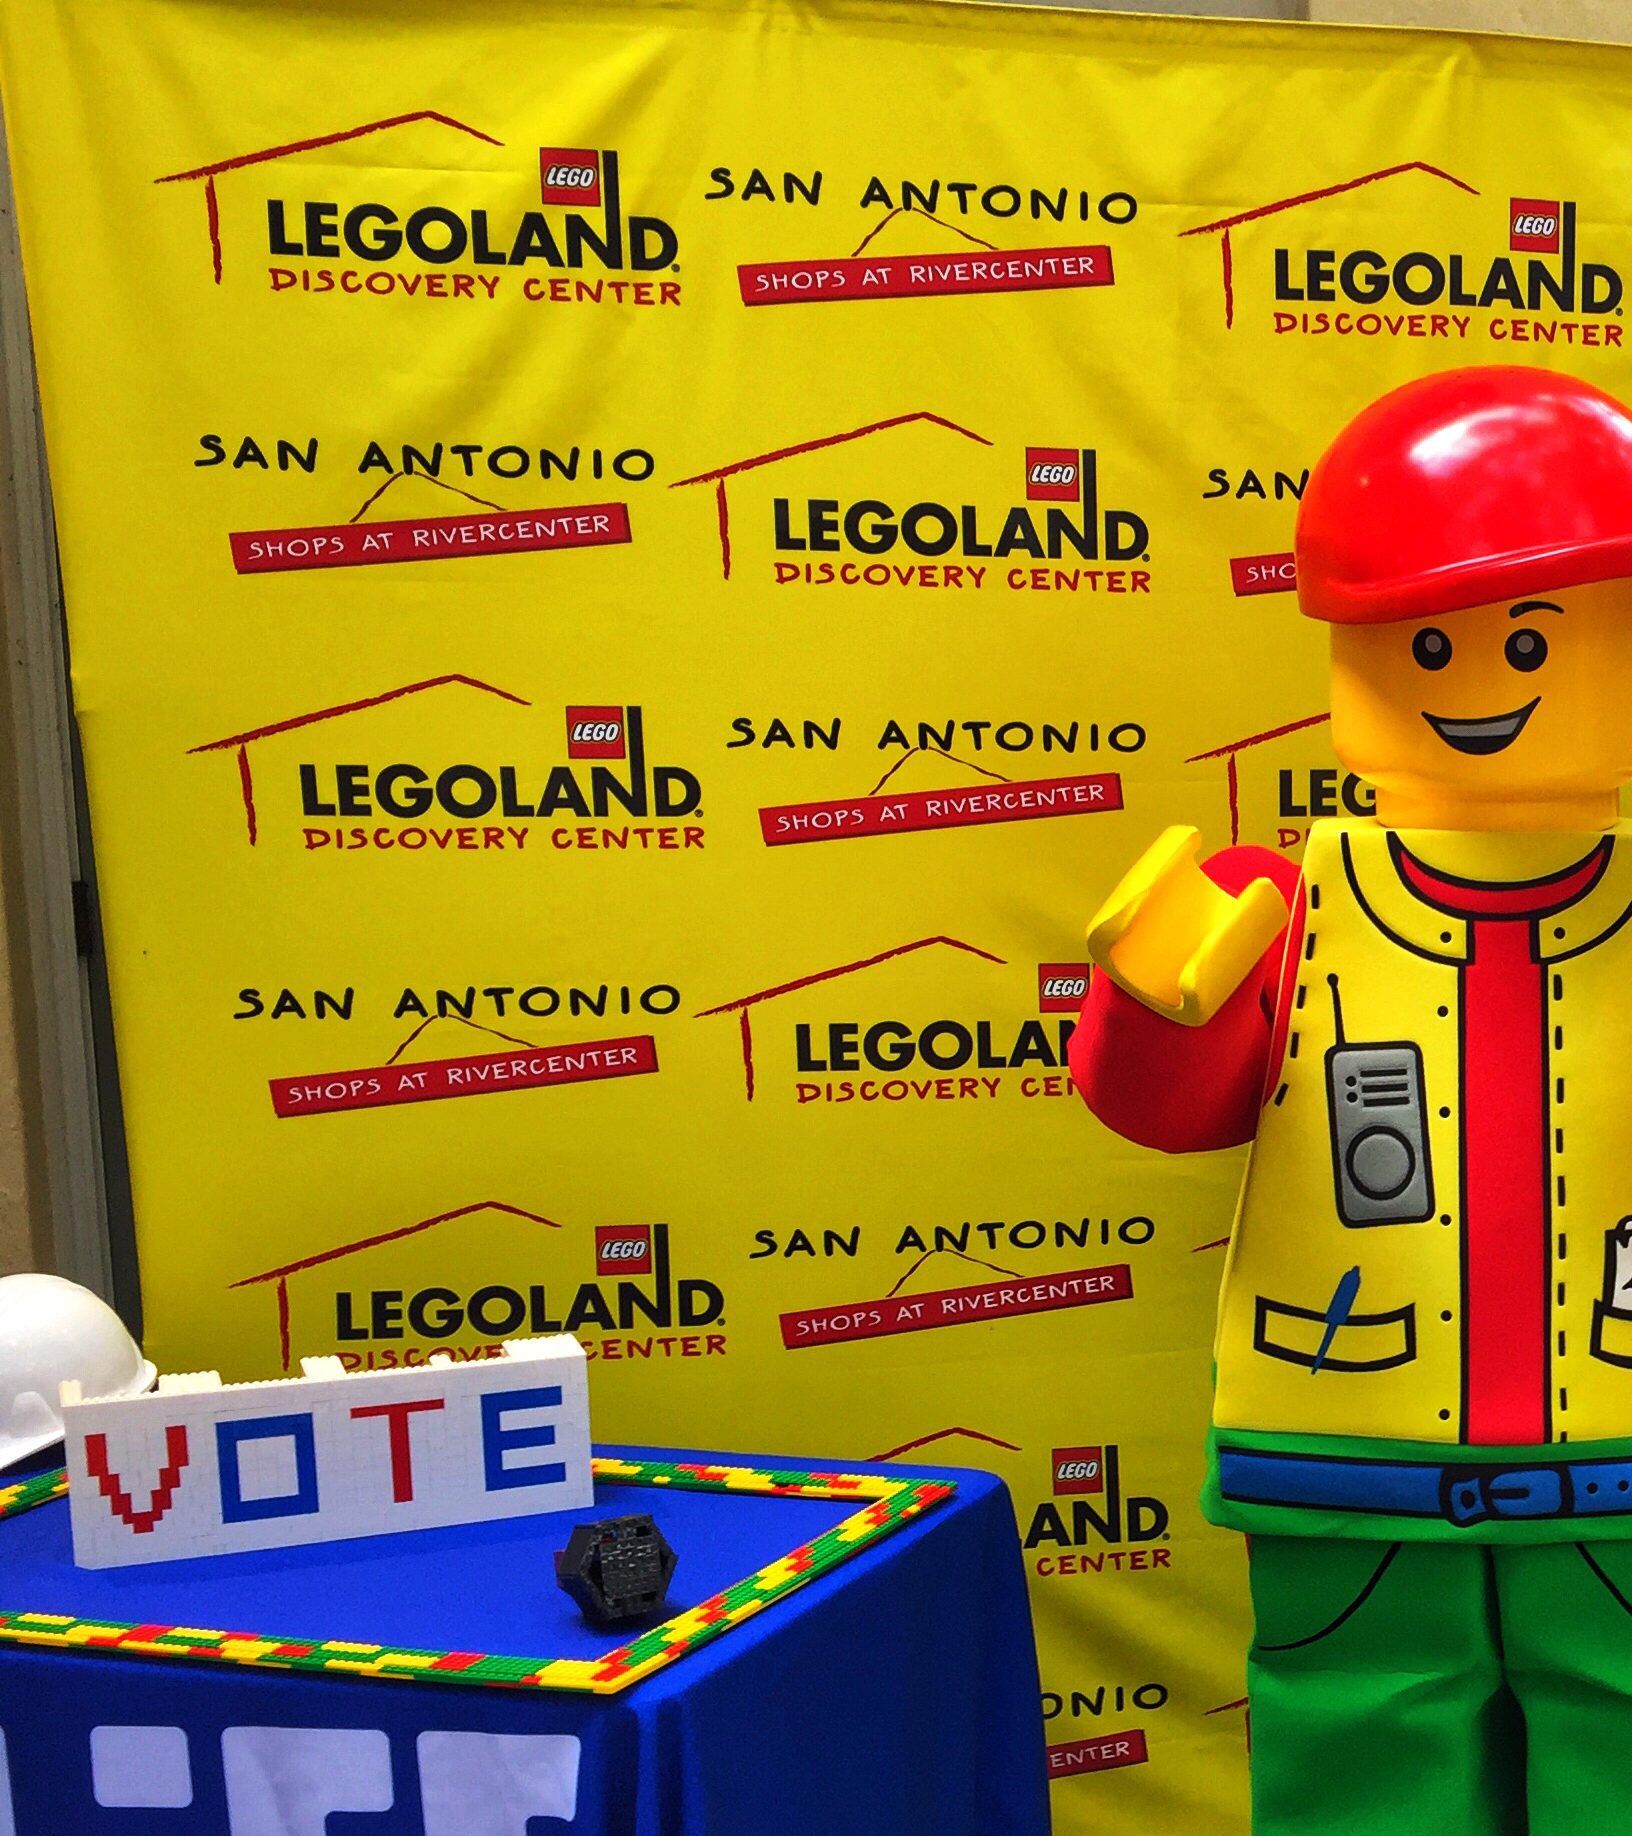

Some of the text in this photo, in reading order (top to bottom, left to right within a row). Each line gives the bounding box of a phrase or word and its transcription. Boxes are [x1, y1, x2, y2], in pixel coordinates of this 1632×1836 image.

[546, 166, 598, 188] LEGO
[704, 167, 1138, 225] SAN ANTONIO
[1514, 215, 1558, 236] LEGO
[268, 267, 681, 306] DISCOVERY CENTER
[756, 256, 1094, 292] SHOPS AT RIVERCENTER
[1273, 312, 1623, 348] DISCOVERY CENTER
[194, 434, 655, 485] SAN ANTONIO
[1031, 464, 1078, 484] LEGO
[1202, 468, 1310, 501] SAN
[249, 515, 610, 560] SHOPS AT RIVERCENTER
[773, 562, 1151, 594] DISCOVERY CENTER
[573, 723, 619, 742] LEGO
[726, 717, 1146, 754] SAN ANTONIO
[776, 784, 1104, 833] SHOPS AT RIVERCENTER
[302, 826, 705, 851] DISCOVERY CENTER
[233, 984, 681, 1021] SAN ANTONIO
[1043, 979, 1086, 997] LEGO
[289, 1047, 637, 1103] SHOPS AT RIVERCENTER
[795, 1076, 1001, 1104] DISCOVERY
[601, 1241, 647, 1259] LEGO
[749, 1216, 1155, 1259] SAN ANTONIO
[797, 1275, 1115, 1335] SHOPS AT RIVERCENTER
[85, 1385, 566, 1534] VOTE
[1057, 1461, 1098, 1480] LEGO
[1035, 1548, 1169, 1577] CENTER
